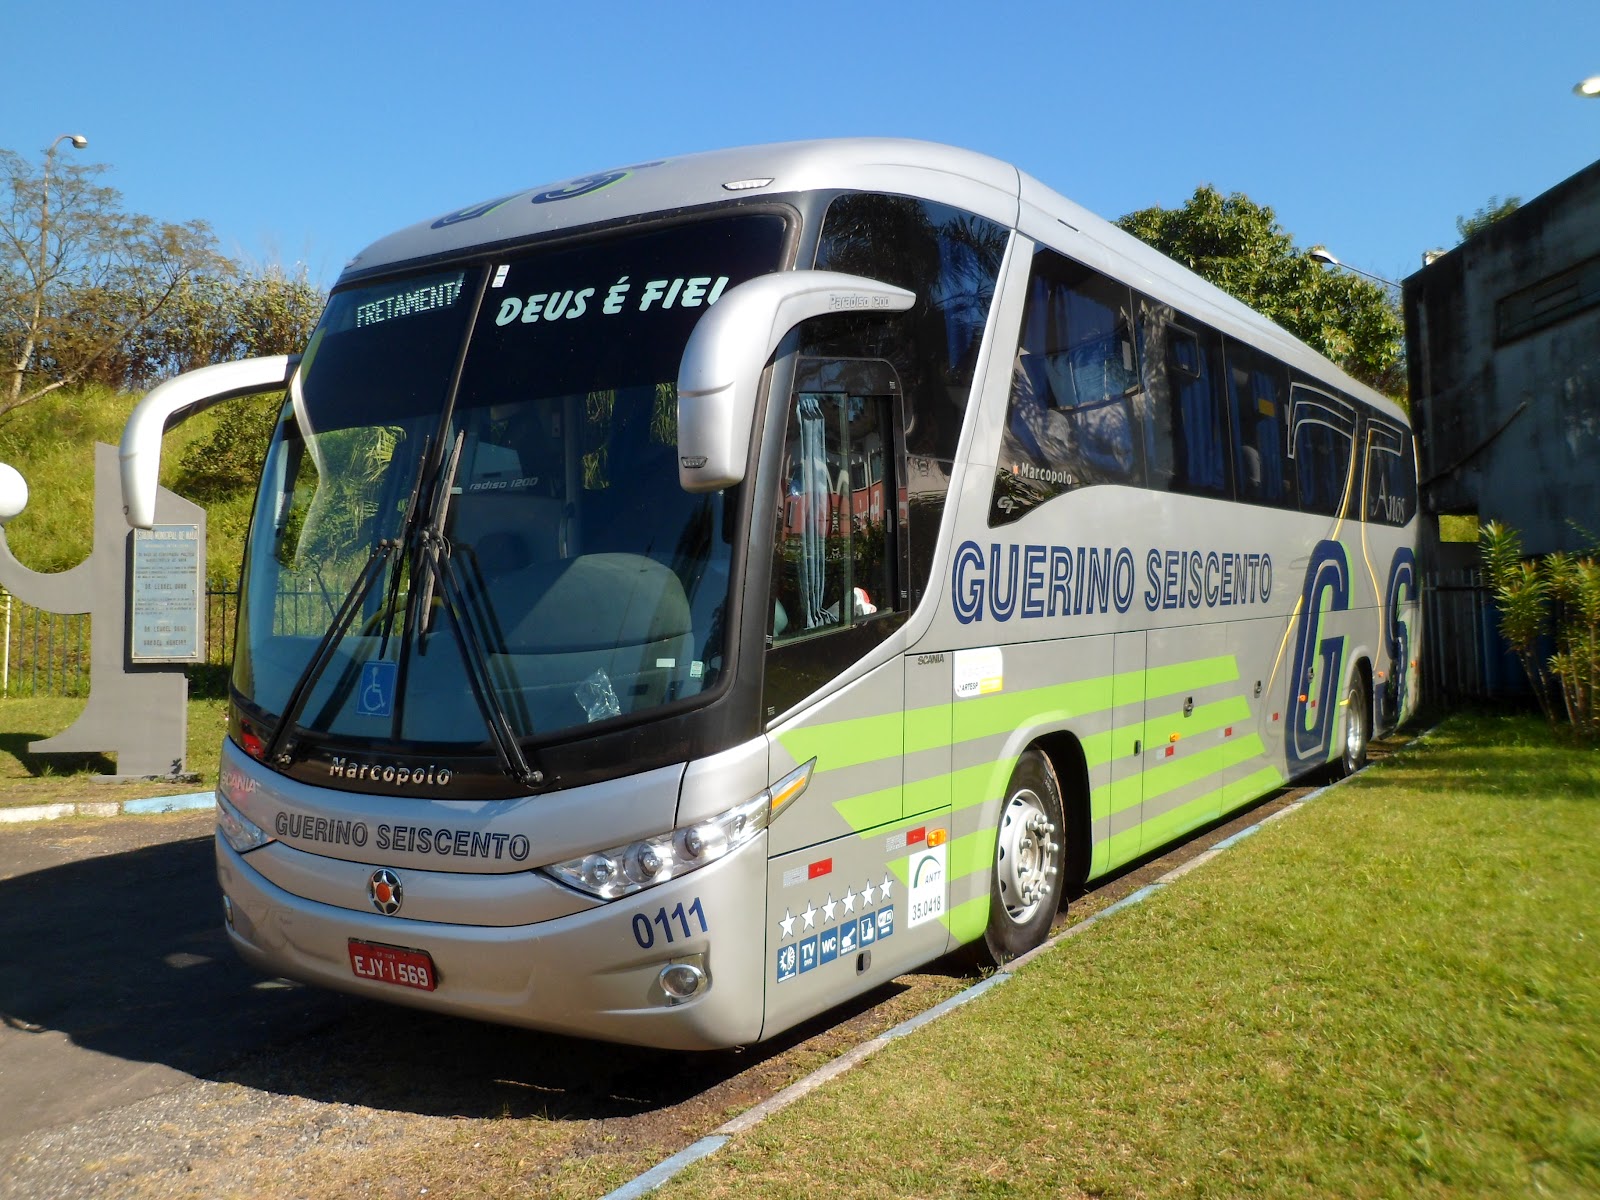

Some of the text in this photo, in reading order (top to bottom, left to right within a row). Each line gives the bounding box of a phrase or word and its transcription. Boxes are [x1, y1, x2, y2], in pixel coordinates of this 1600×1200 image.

[495, 287, 596, 327] DEUS
[602, 275, 631, 315] É
[829, 293, 890, 310] Paradiso 1200
[469, 477, 539, 490] radiso 1200
[1021, 462, 1072, 485] Marcopolo
[952, 540, 1273, 625] GUERINO SEISCENTO
[918, 654, 945, 666] SCANIA
[329, 757, 453, 786] Marcopolo
[275, 811, 530, 862] GUERINO SEISCENTO
[925, 870, 942, 885] ANTT
[912, 895, 941, 921] 35.0418
[632, 896, 709, 949] 0111
[801, 942, 815, 959] TV
[821, 937, 836, 954] WC
